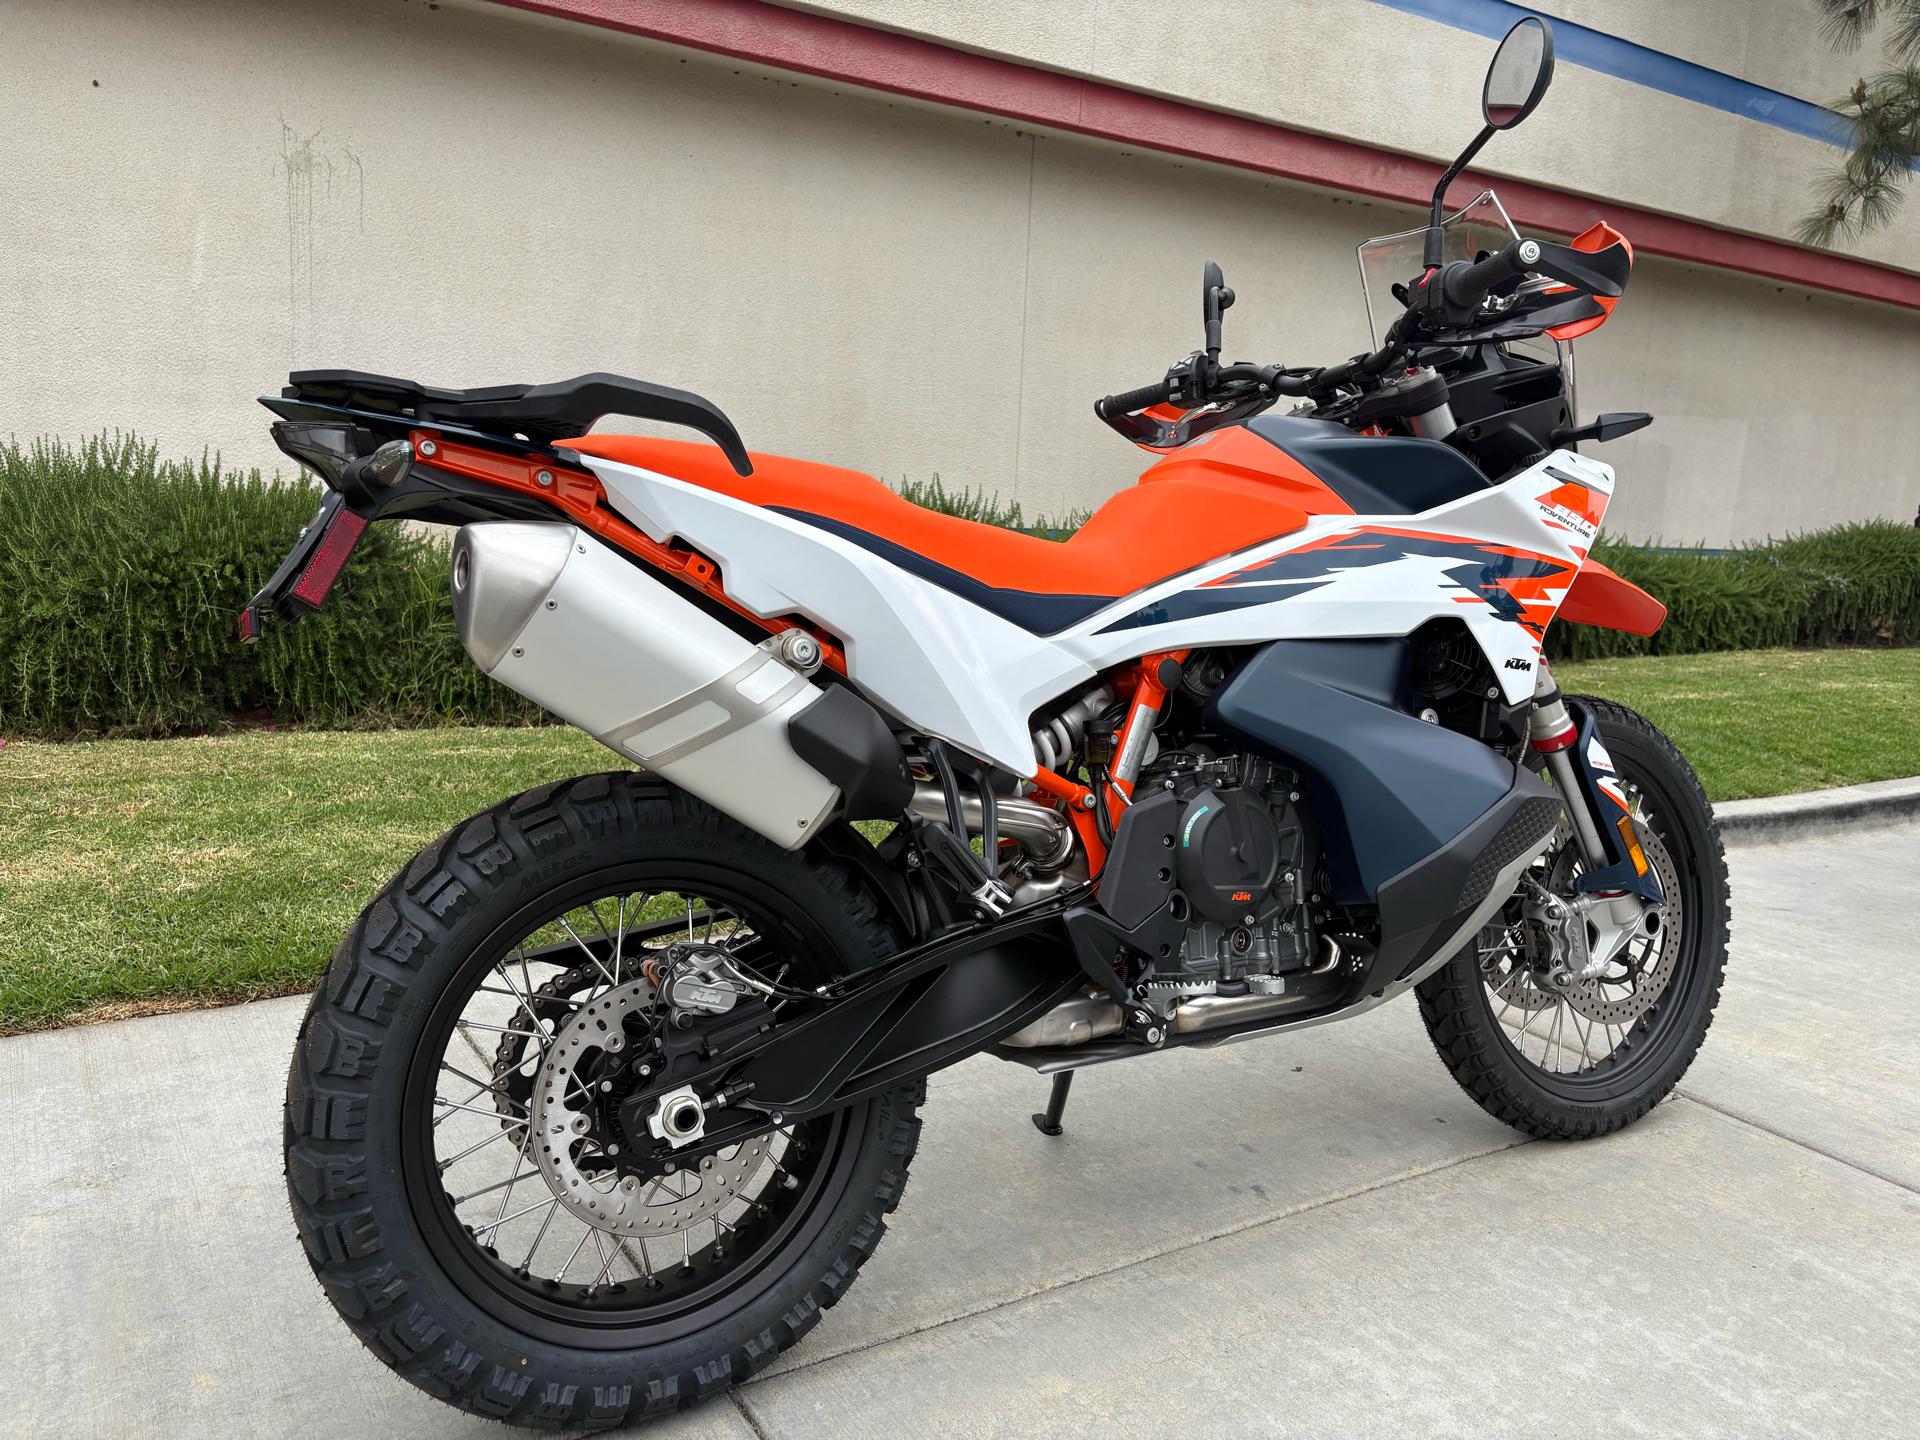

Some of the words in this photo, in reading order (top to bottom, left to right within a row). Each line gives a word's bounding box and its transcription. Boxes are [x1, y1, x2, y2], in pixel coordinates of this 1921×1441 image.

[1540, 505, 1591, 539] ADVENTURE
[1504, 658, 1532, 672] KTM
[517, 850, 594, 897] Mitas
[1231, 891, 1252, 901] KTM
[689, 989, 723, 1004] KTM
